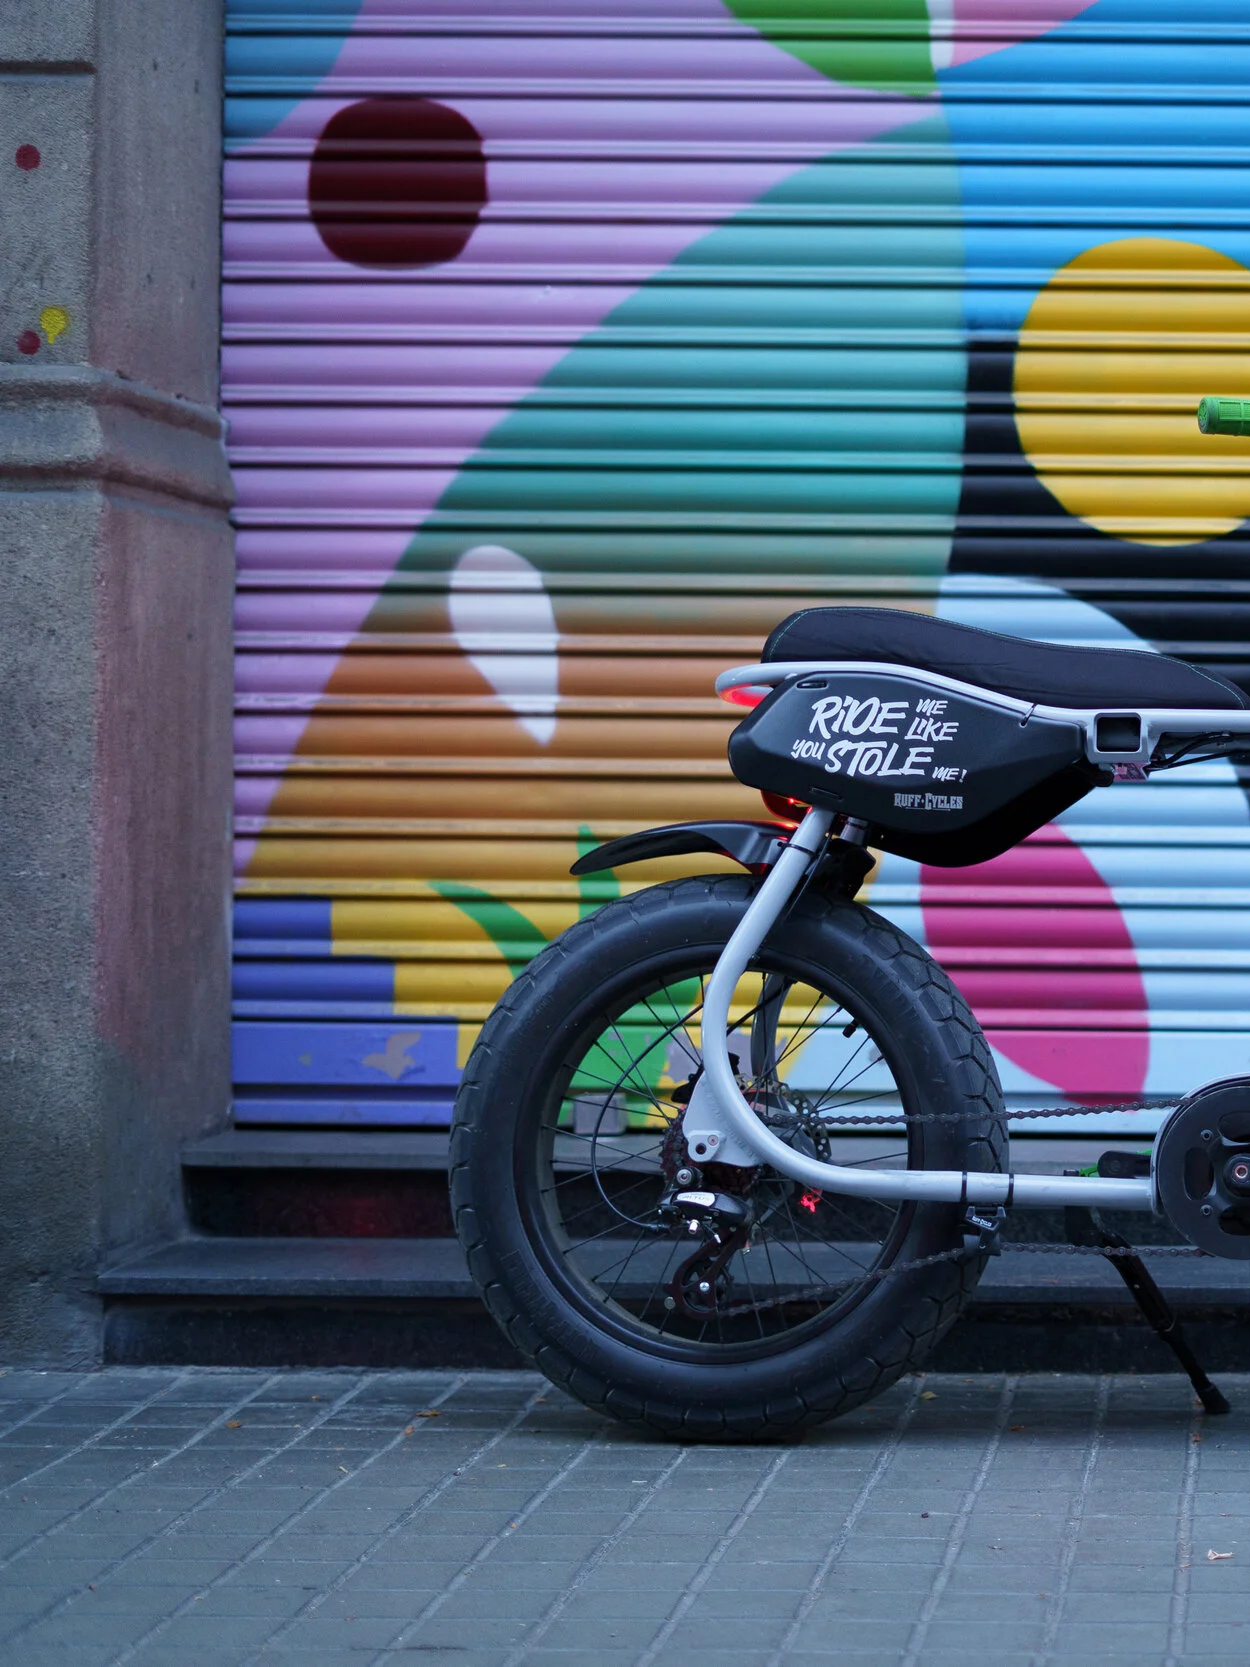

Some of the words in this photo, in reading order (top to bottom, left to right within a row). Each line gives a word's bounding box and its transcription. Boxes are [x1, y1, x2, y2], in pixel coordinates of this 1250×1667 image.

[915, 698, 949, 716] ME
[904, 716, 960, 741] LIKE
[824, 739, 935, 777] STOLE
